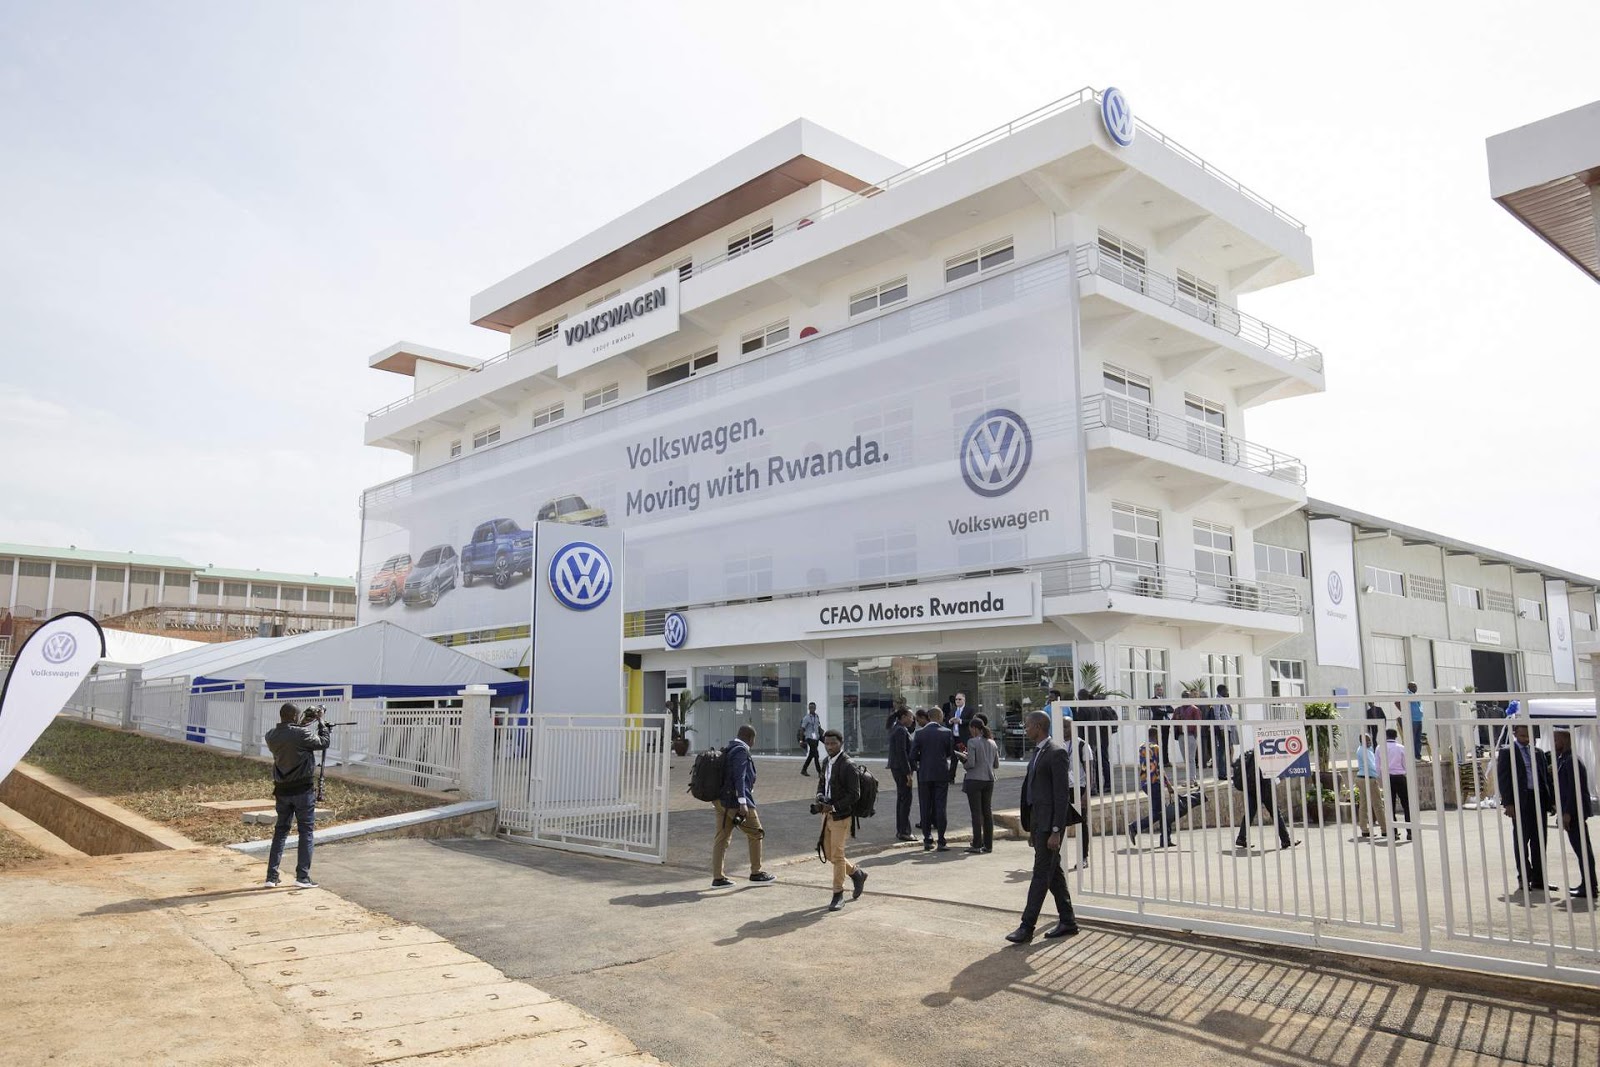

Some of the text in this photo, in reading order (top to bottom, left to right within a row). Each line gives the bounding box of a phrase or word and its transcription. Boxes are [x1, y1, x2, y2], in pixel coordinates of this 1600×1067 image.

[564, 286, 666, 347] VOLKSWAGEN
[626, 417, 764, 470] Volkswagen.
[626, 435, 889, 517] Moving with Rwanda.
[948, 508, 1049, 535] Volkswagen
[820, 591, 1004, 625] CFAO Motors Rwanda
[492, 648, 518, 661] BRANCH
[31, 669, 79, 677] Volkswagen
